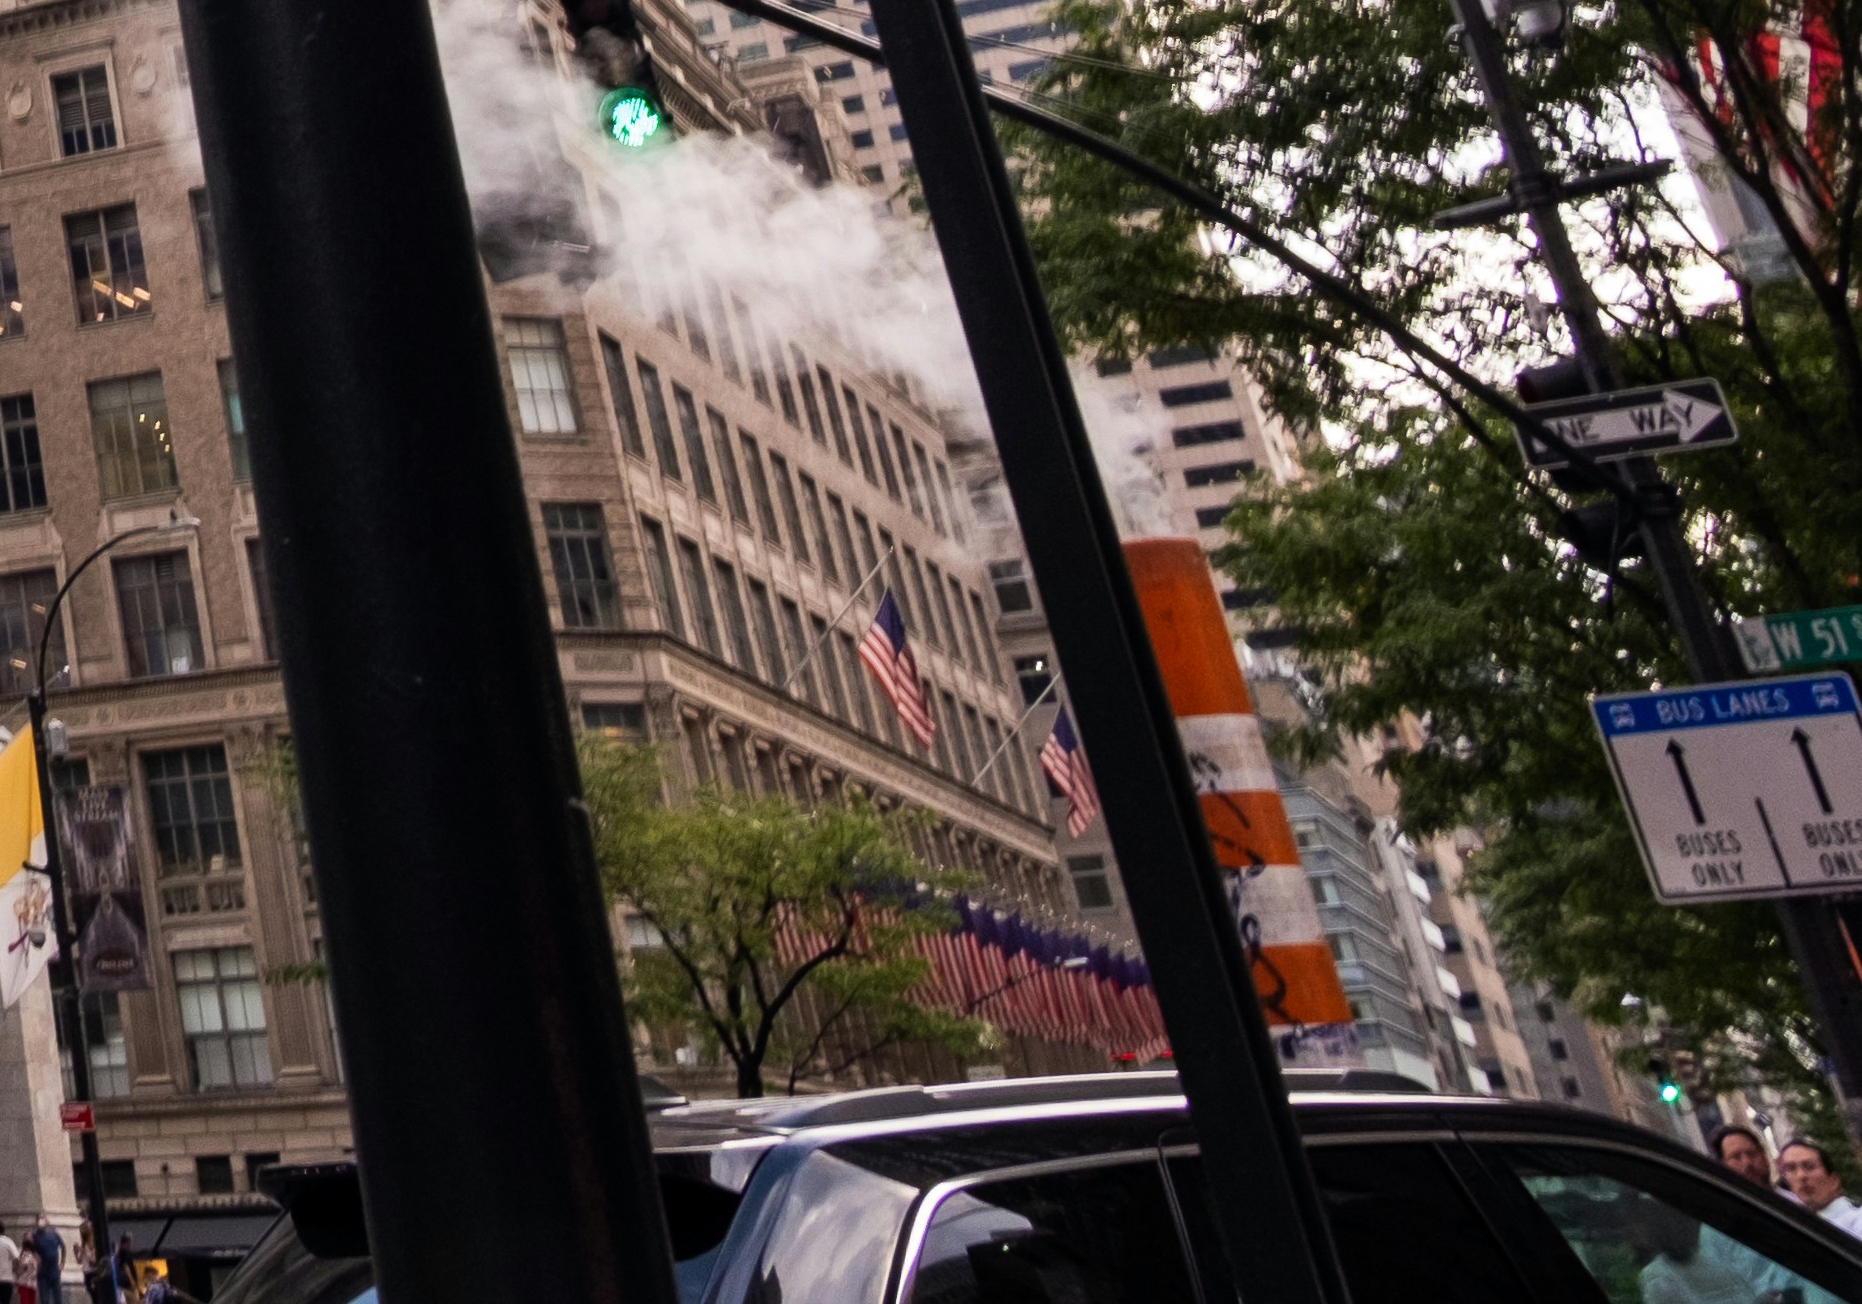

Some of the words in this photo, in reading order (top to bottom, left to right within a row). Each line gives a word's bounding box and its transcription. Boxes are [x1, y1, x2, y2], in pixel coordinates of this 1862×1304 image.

[1628, 398, 1695, 433] WAY
[1771, 621, 1803, 662] W
[1811, 616, 1850, 659] 51
[1656, 696, 1705, 725] BUS
[1711, 688, 1790, 720] LANES
[1676, 829, 1743, 858] BUSES
[1691, 861, 1745, 888] ONLY
[1819, 849, 1862, 878] ONL
